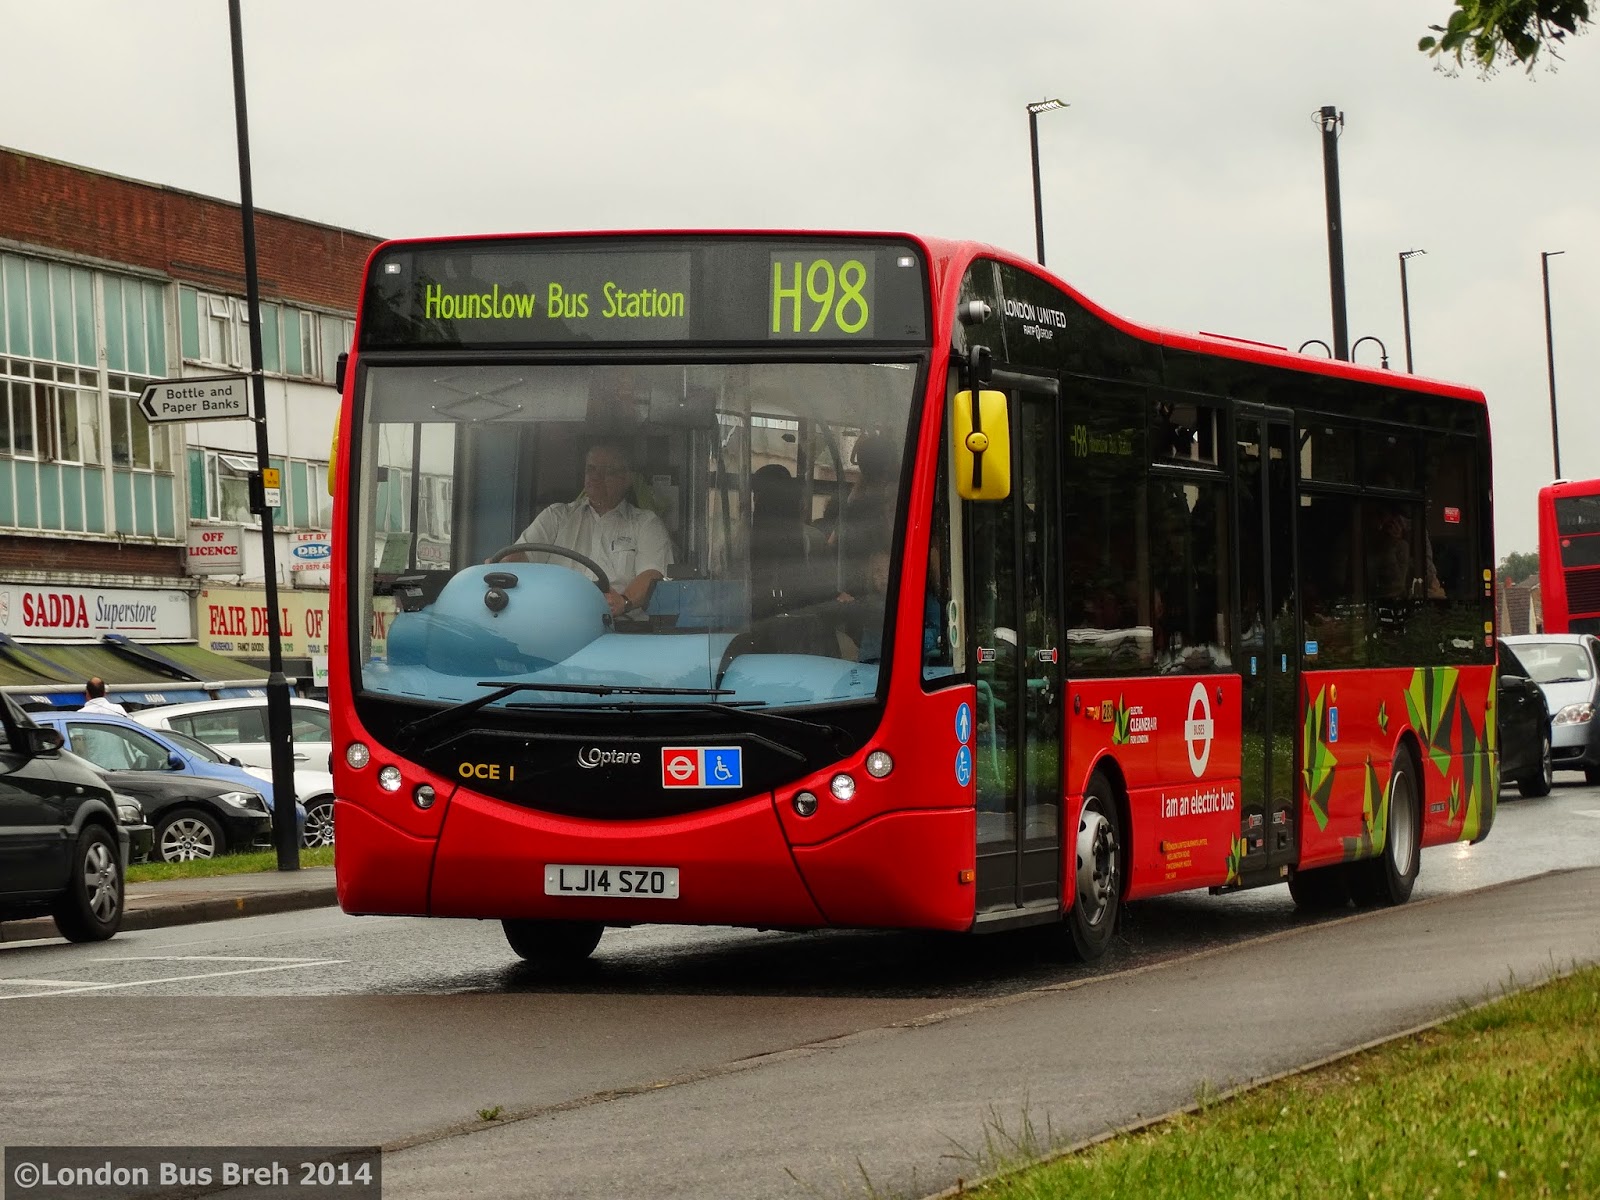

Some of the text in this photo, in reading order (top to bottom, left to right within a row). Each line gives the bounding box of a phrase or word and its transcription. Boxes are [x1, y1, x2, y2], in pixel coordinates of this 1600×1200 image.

[425, 282, 684, 320] Hounslow Bus Station
[773, 259, 869, 334] H98
[1003, 299, 1067, 328] LONDON UNITED
[166, 386, 232, 399] Bottle and
[162, 399, 239, 414] Paper Banks
[202, 532, 224, 542] OFF
[189, 546, 238, 556] LICENCE
[297, 546, 329, 555] DBK
[23, 592, 156, 629] SADDA Superstore
[209, 605, 247, 636] FAIR
[251, 607, 293, 637] DEL
[305, 608, 323, 638] OF
[210, 642, 233, 651] HOUSEHOLD
[1194, 725, 1205, 735] BUSES
[579, 747, 641, 769] Optare
[459, 762, 500, 780] OCE
[1161, 787, 1235, 818] I am an electric bus
[559, 869, 611, 892] LJ14
